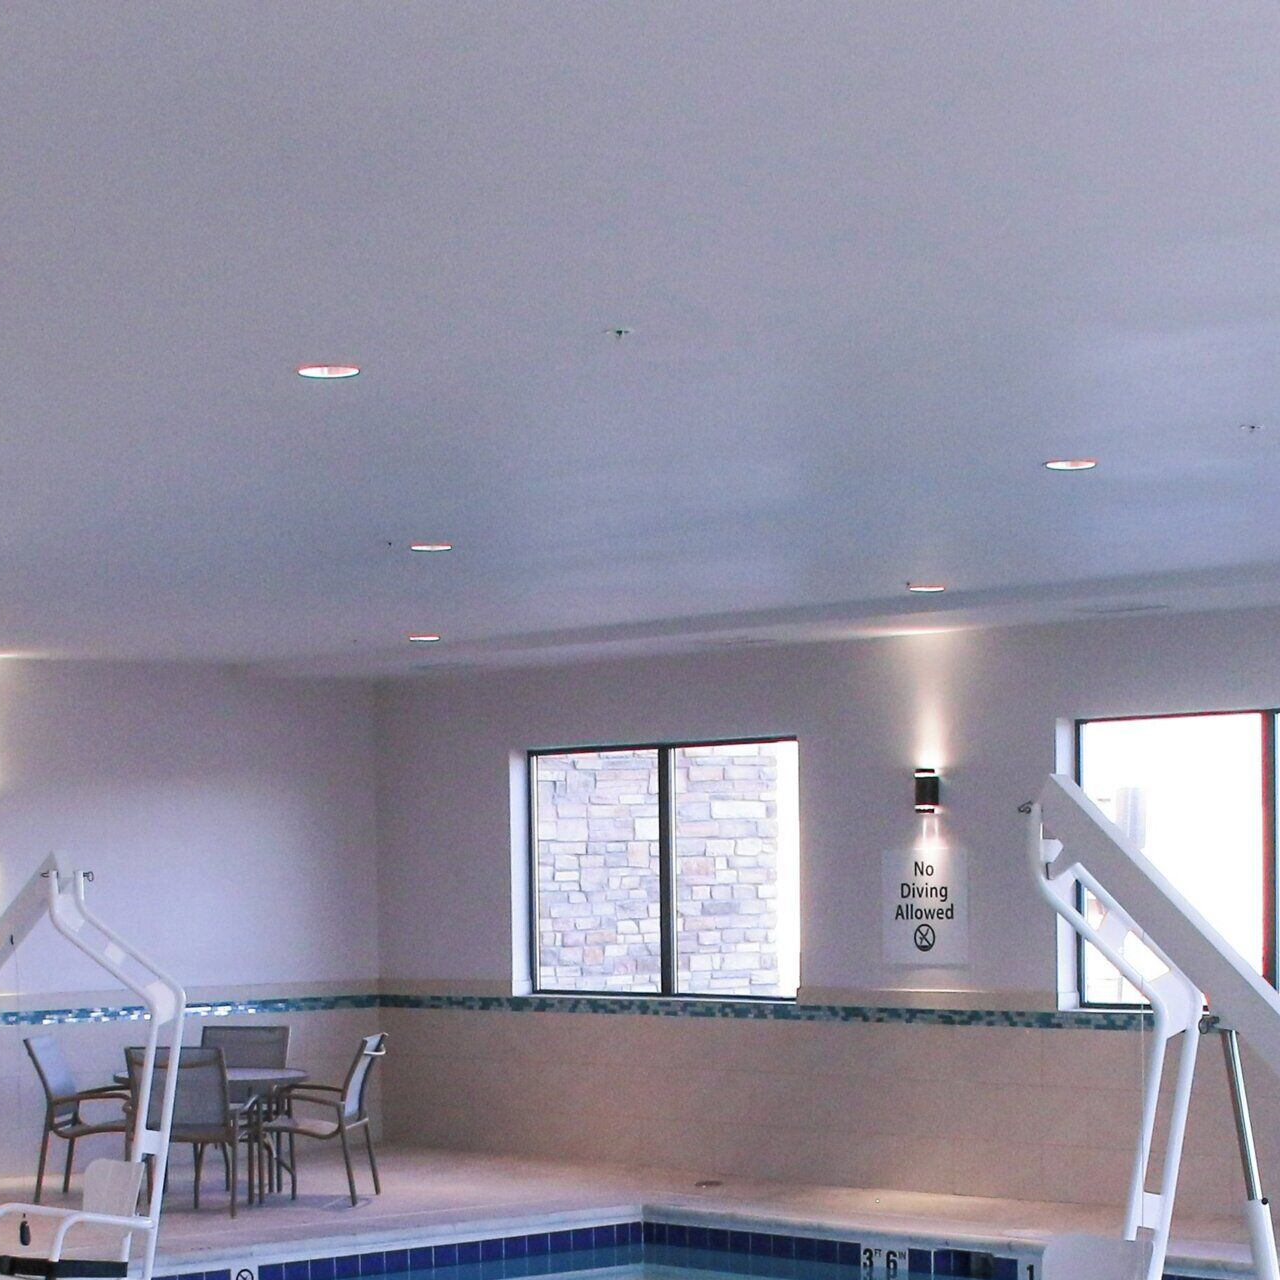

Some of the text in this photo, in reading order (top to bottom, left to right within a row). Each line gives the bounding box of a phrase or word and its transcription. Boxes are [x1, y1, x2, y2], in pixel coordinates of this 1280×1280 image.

[914, 861, 934, 876] No
[900, 883, 948, 902] Diving
[895, 903, 954, 920] Allowed
